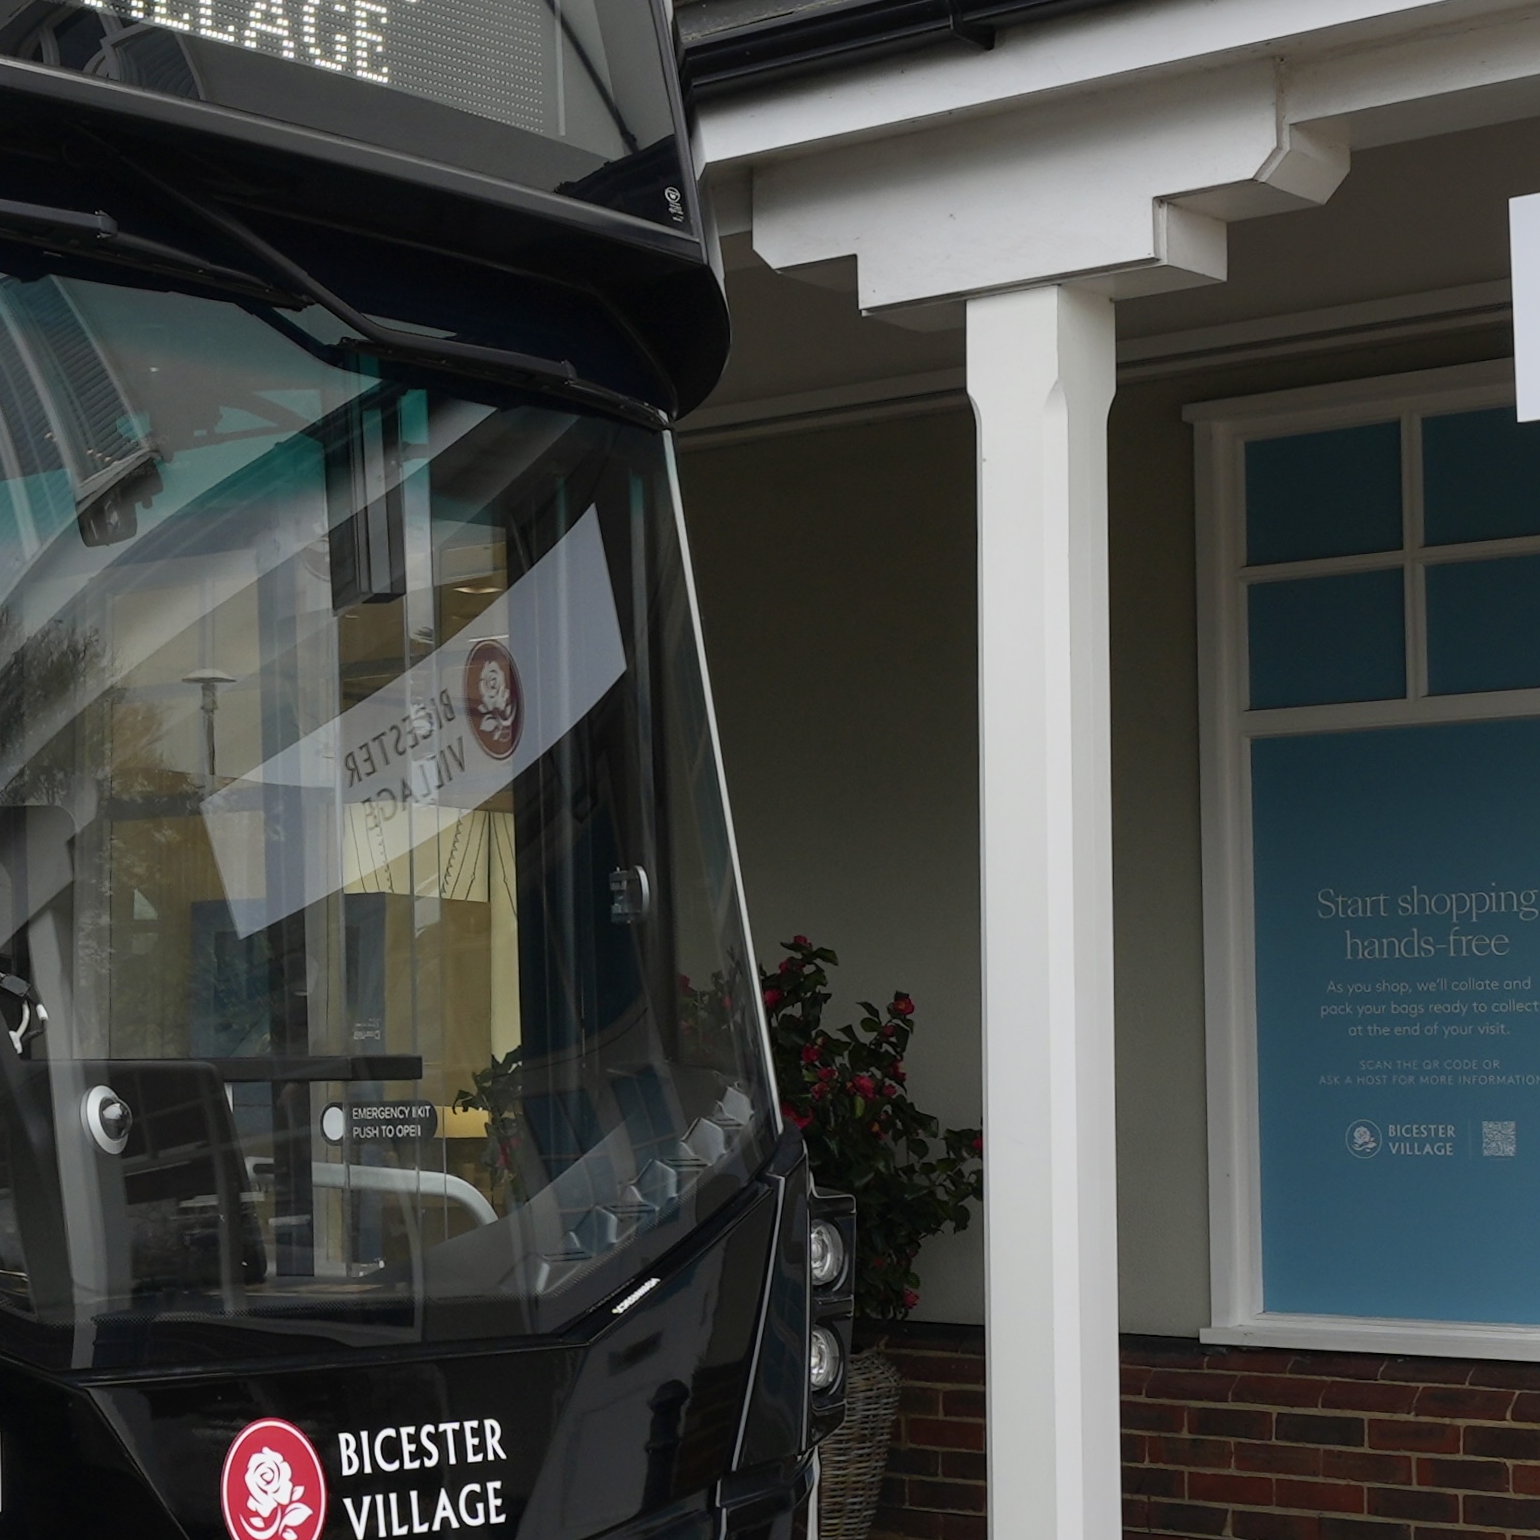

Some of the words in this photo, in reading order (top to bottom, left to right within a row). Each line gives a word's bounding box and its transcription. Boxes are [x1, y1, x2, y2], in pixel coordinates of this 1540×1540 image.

[1317, 888, 1390, 920] Start
[1397, 882, 1540, 924] shopping
[1345, 926, 1511, 960] hands-free
[1327, 980, 1343, 993] As
[1347, 982, 1371, 996] you
[1375, 979, 1412, 995] shop,
[1451, 977, 1499, 991] collate
[1503, 977, 1531, 990] and
[1320, 1002, 1352, 1018] pack
[1357, 1003, 1386, 1017] your
[1391, 1001, 1425, 1017] bags
[1428, 1000, 1468, 1016] ready
[1473, 1002, 1487, 1013] to
[1491, 1000, 1540, 1013] collect
[1348, 1024, 1363, 1036] at
[1367, 1023, 1390, 1036] the
[1393, 1023, 1420, 1036] end
[1424, 1022, 1438, 1035] of
[1443, 1024, 1473, 1038] your
[1477, 1022, 1511, 1035] visit.
[1359, 1060, 1392, 1070] SCAN
[1396, 1060, 1418, 1070] THE
[1422, 1060, 1439, 1070] QR
[1443, 1060, 1478, 1070] CODE
[1482, 1060, 1500, 1069] OR
[1318, 1075, 1340, 1085] ASK
[1345, 1075, 1352, 1085] A
[1357, 1075, 1387, 1085] HOST
[1392, 1075, 1415, 1085] FOR
[1419, 1075, 1454, 1085] MORE
[352, 1107, 410, 1119] EMERGENCY
[353, 1126, 379, 1138] PUSH
[381, 1125, 395, 1138] TO
[1388, 1124, 1456, 1138] BICESTER
[1388, 1142, 1454, 1156] VILLAGE
[337, 1418, 507, 1477] BICESTER
[342, 1481, 507, 1540] VILLAGE
